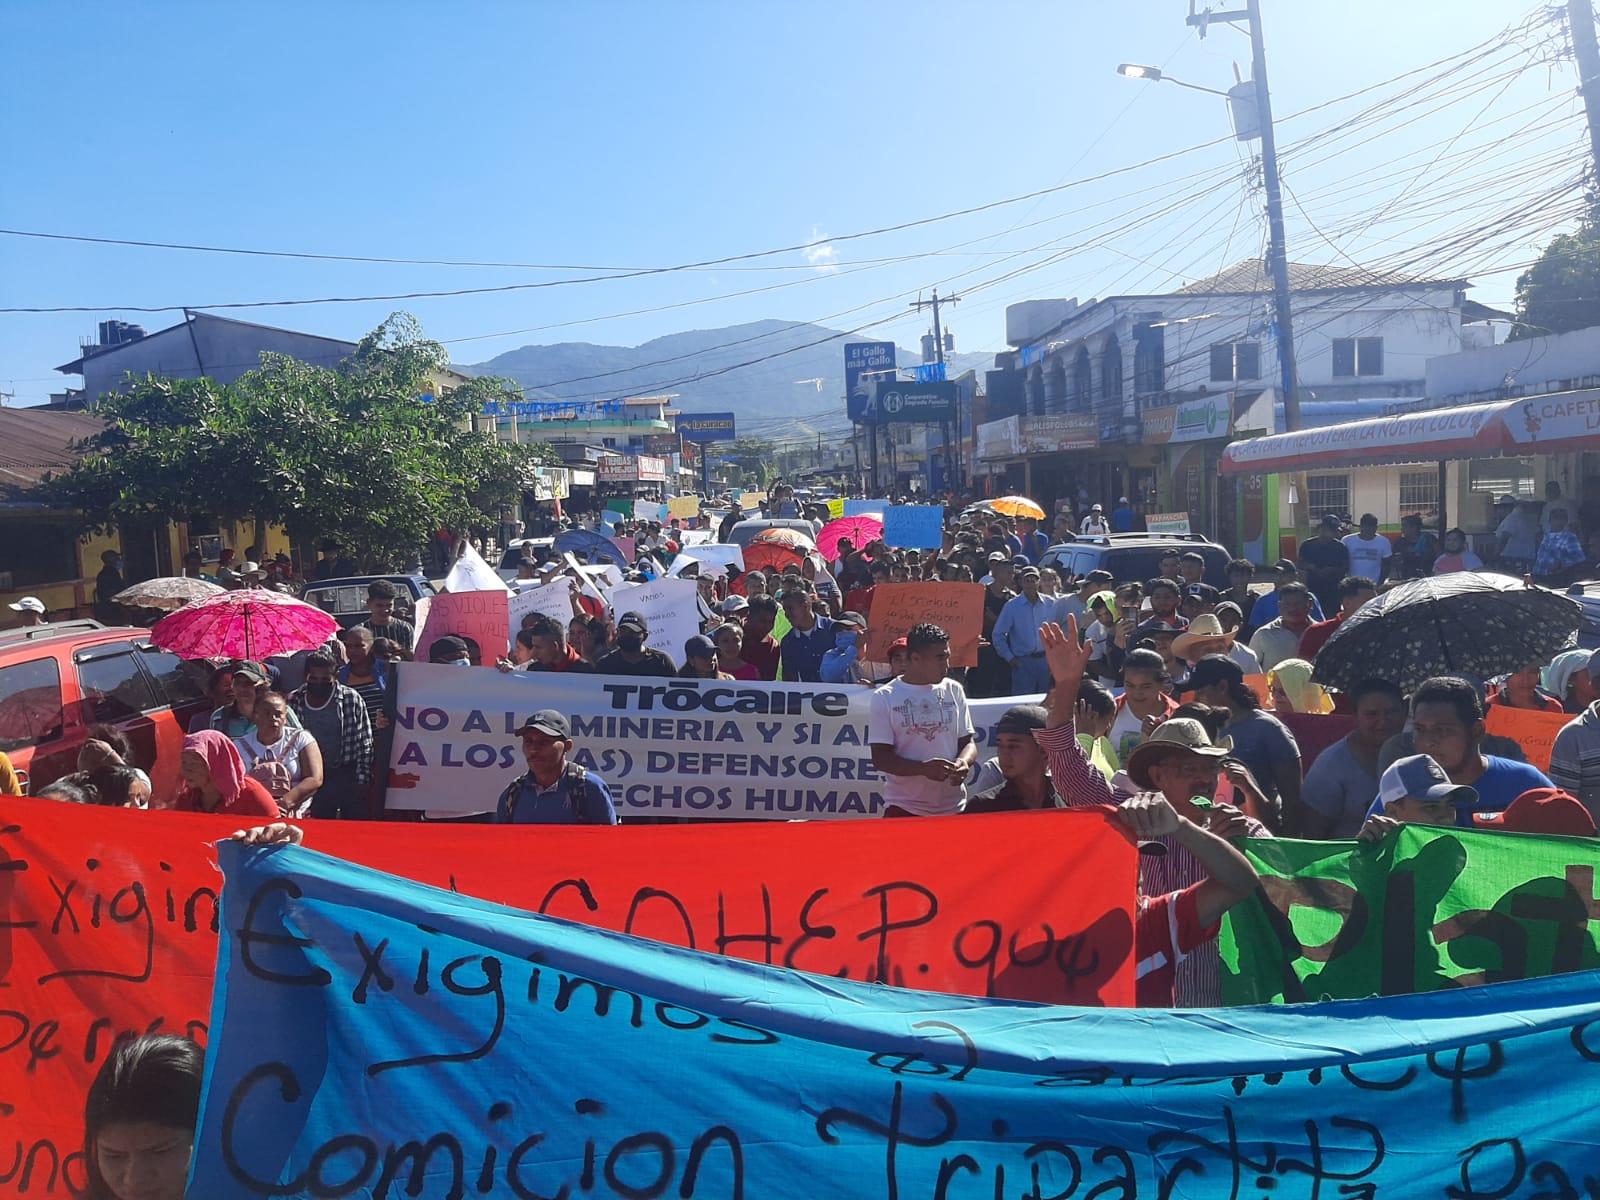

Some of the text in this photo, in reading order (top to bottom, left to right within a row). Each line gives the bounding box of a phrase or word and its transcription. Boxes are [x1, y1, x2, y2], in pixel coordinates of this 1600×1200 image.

[852, 346, 886, 358] El Gallo
[868, 355, 891, 367] Gallo
[1541, 400, 1600, 418] CAFET
[1358, 425, 1374, 440] LA
[1377, 419, 1425, 438] NUEVA
[639, 591, 665, 603] VAMOS
[462, 710, 492, 733] A
[571, 714, 744, 742] MINERIA
[756, 722, 782, 744] Y
[793, 722, 821, 745] SI
[397, 742, 428, 766] A
[441, 743, 515, 768] LOS
[646, 750, 887, 782] DEFENSORE
